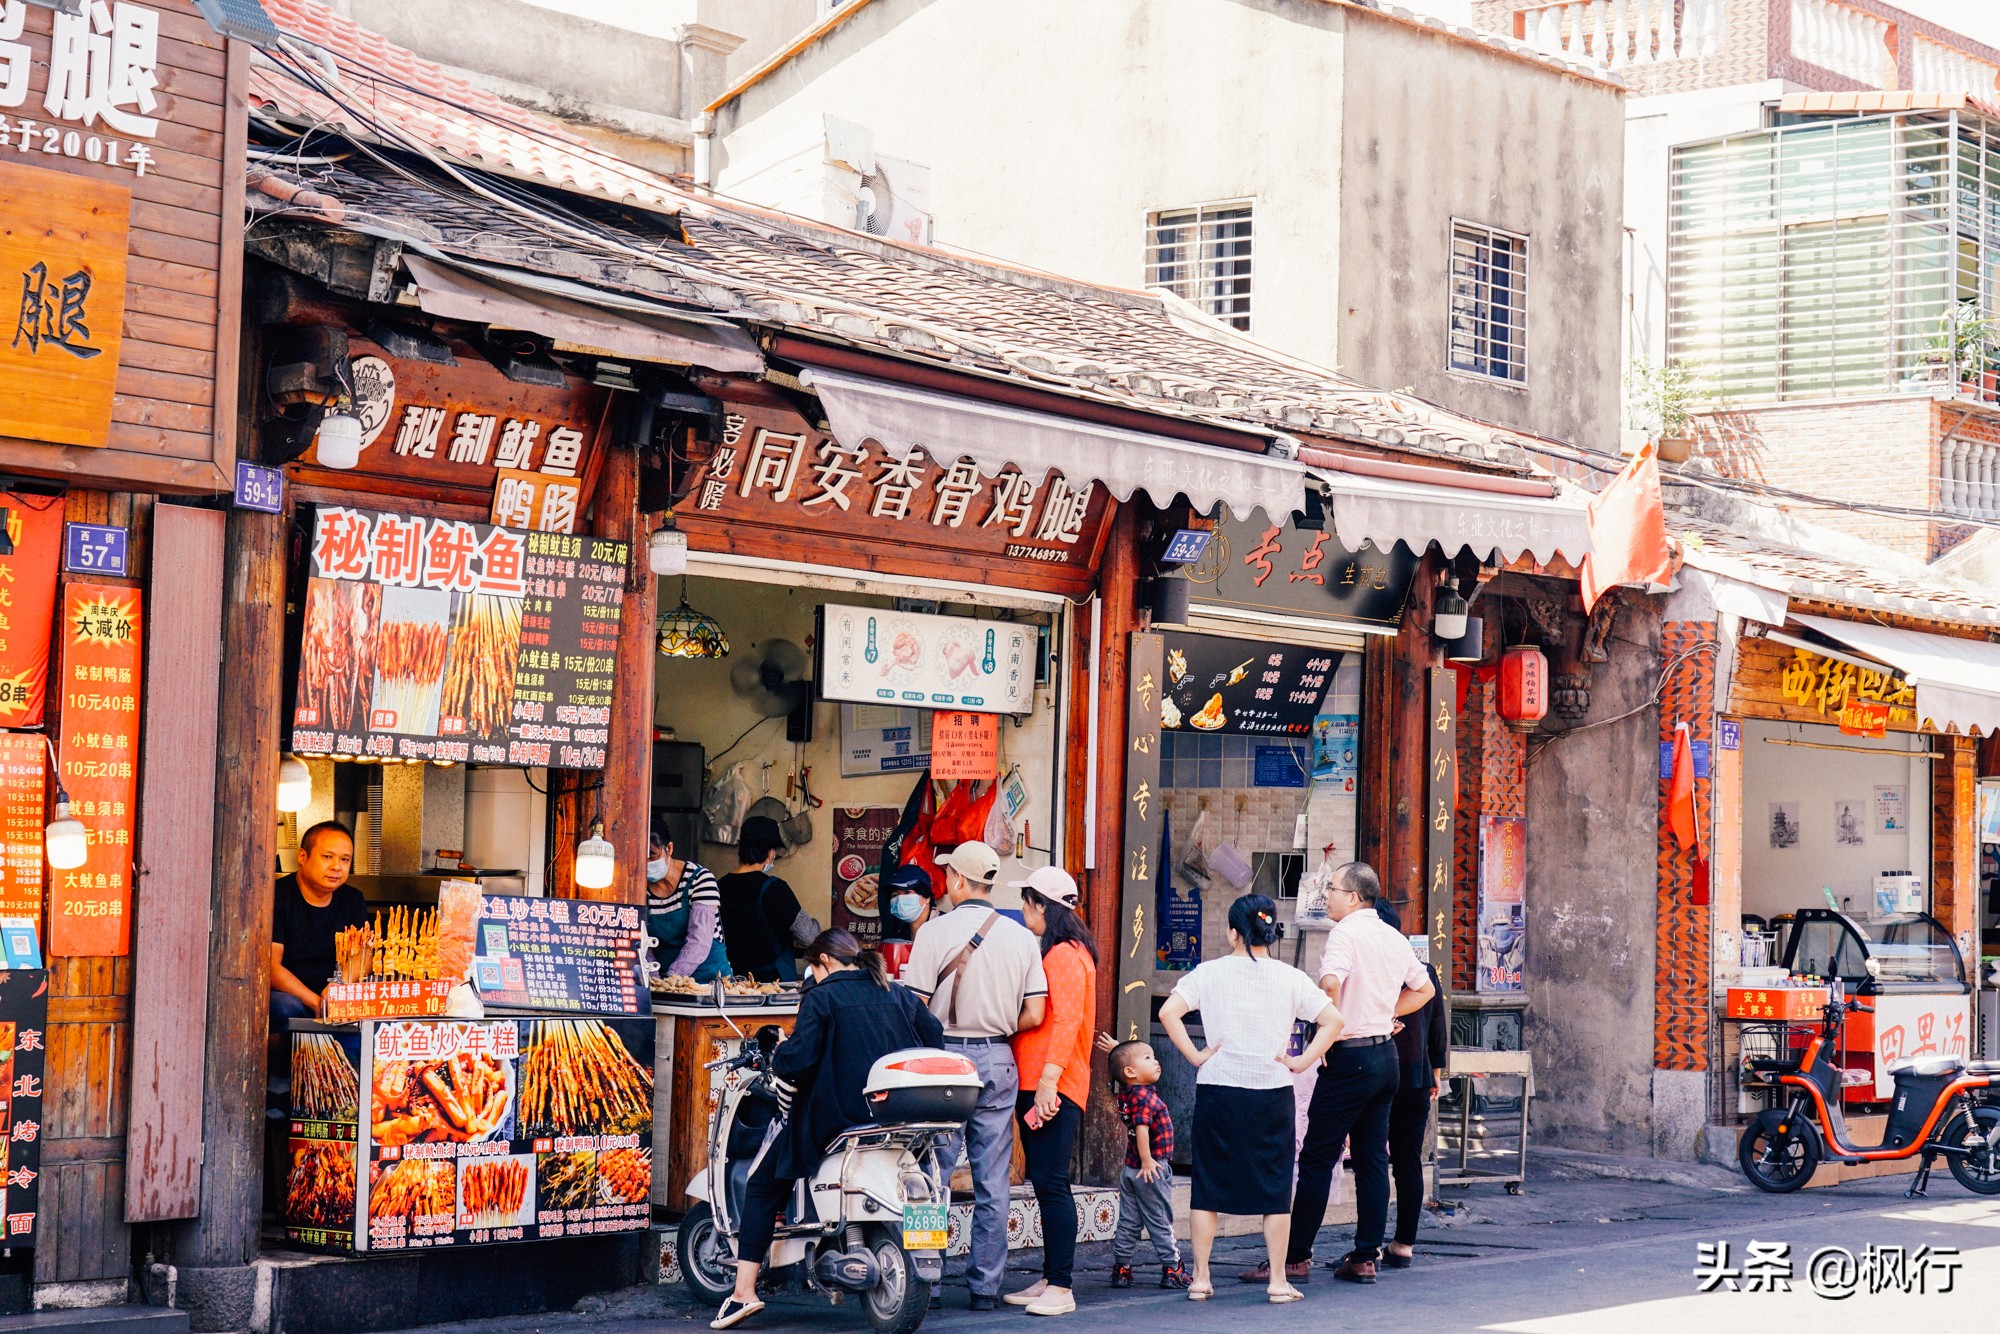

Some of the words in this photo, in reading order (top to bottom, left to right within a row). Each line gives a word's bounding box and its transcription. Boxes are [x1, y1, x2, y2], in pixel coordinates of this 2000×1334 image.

[12, 261, 102, 358] 腿
[393, 404, 583, 477] 秘制鱿鱼
[244, 481, 273, 505] 59-1
[738, 427, 1092, 544] 同安香骨鸡腿
[496, 478, 579, 534] 鸭肠
[80, 546, 107, 568] 57
[316, 510, 525, 596] 秘制鱿鱼
[528, 532, 582, 559] 秘制鱿鱼须
[590, 541, 628, 565] 20元/碗
[1171, 543, 1196, 558] 59-2
[525, 556, 576, 578] 鱿鱼炒年糕
[578, 563, 626, 584] 20元/碗4串
[1340, 562, 1387, 590] 生煎包
[524, 576, 567, 599] 大鱿鱼串
[581, 584, 624, 605] 20元/7串
[91, 605, 119, 618] 周年庆
[523, 597, 553, 614] 大肉串
[583, 605, 621, 621] 15元/份11串
[77, 617, 132, 640] 大减价
[518, 649, 560, 671] 小鱿鱼串
[563, 656, 614, 674] 15元/份20串
[75, 664, 131, 683] 秘制鸭肠
[516, 672, 545, 687] 鱿鱼须串
[575, 678, 613, 691] 15元/份15串
[1783, 650, 1920, 724] 西街四果
[69, 694, 135, 714] 10元40串
[513, 689, 554, 703] 网红面筋串
[568, 694, 611, 706] 10元/份30串
[298, 709, 316, 723] 招牌
[375, 711, 395, 727] 招牌
[512, 701, 544, 721] 小鲜肉
[953, 714, 979, 727] 招聘
[443, 717, 463, 733] 招牌
[509, 724, 571, 742] 一整只大鱿鱼
[574, 729, 608, 744] 10元/只
[72, 732, 128, 750] 小鱿鱼串
[1724, 732, 1735, 746] 67
[25, 753, 43, 762] 10元
[560, 745, 605, 768] 10元/30串
[8, 765, 43, 776] 10元40串
[65, 760, 133, 779] 10元20串
[8, 779, 43, 789] 10元30串
[7, 793, 43, 802] 10元15串
[65, 871, 123, 889] 大鱿鱼串
[65, 899, 123, 918] 20元8串
[577, 904, 639, 929] 20元/碗
[509, 942, 551, 954] 小鱿鱼串
[380, 982, 421, 999] 大鱿鱼串
[1743, 991, 1768, 1004] 安海
[1800, 991, 1814, 1004] 安海
[380, 1000, 419, 1016] 7串/20元
[425, 997, 447, 1013] 10元
[1736, 1004, 1774, 1017] 土笋冻
[376, 1021, 519, 1060] 鱿鱼炒年糕
[7, 1028, 45, 1236] 东北烤冷面
[906, 1215, 945, 1230] 9689G
